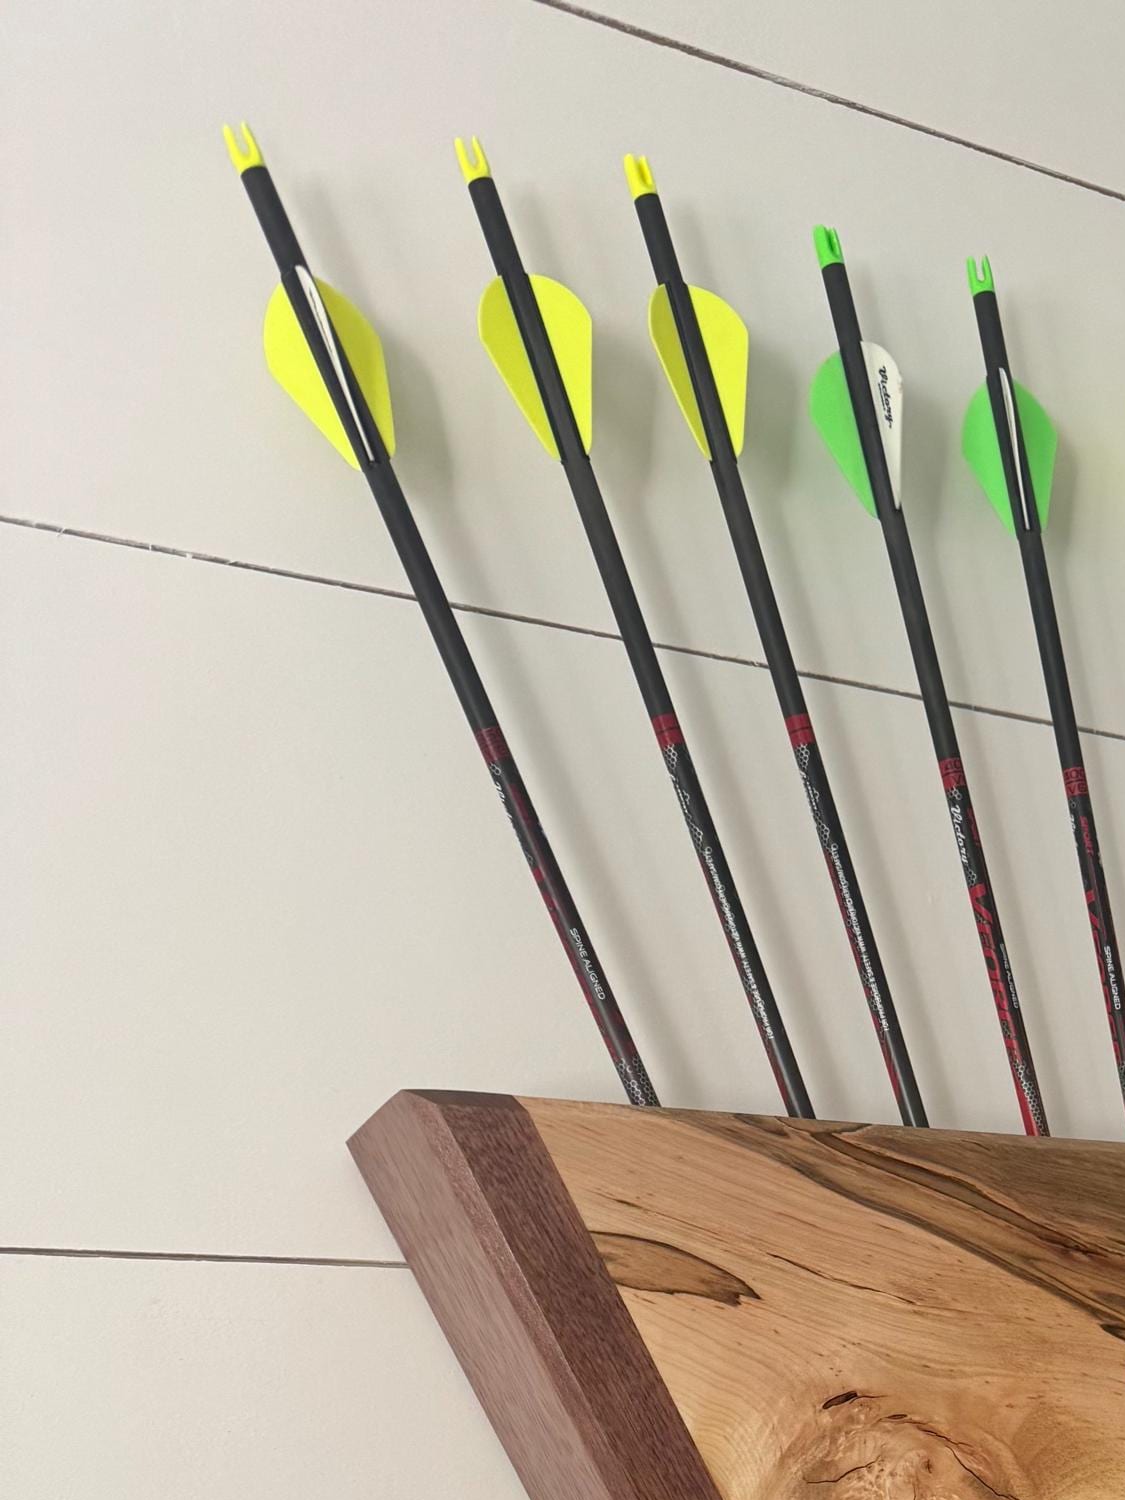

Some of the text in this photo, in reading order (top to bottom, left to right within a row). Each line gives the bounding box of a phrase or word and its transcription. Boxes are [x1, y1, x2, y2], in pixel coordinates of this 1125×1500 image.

[878, 365, 894, 429] Victory
[950, 804, 970, 864] Victory
[570, 927, 606, 1001] SPINE ALIGNED
[1103, 945, 1121, 1010] SPINE ALIGNED
